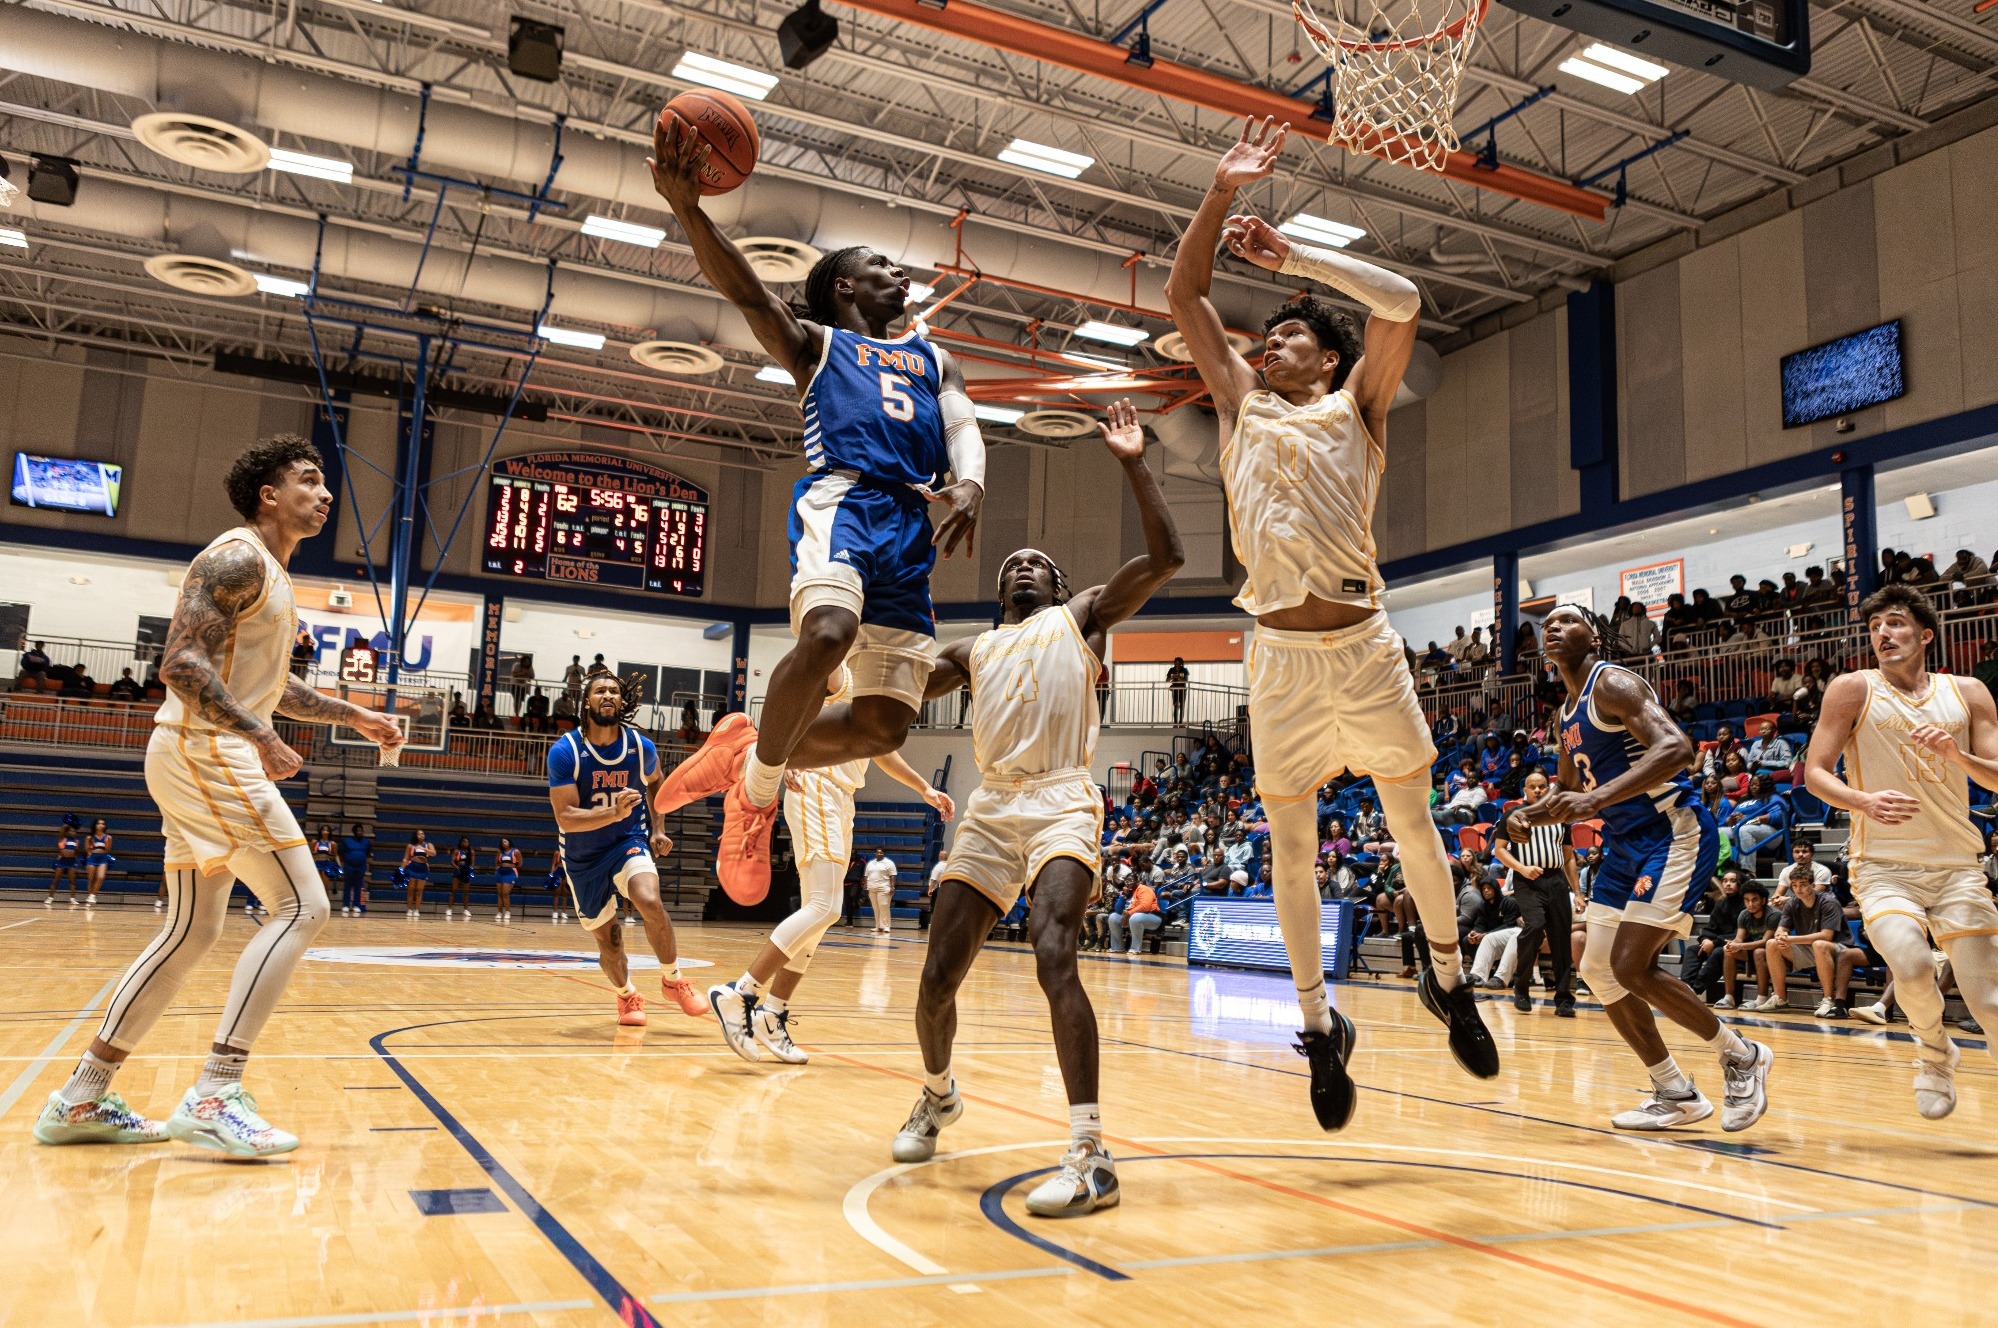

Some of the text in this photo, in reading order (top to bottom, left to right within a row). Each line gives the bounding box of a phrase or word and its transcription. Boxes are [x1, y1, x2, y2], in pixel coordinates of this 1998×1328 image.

[698, 106, 739, 152] NAIA
[856, 344, 924, 376] FMU
[879, 372, 914, 423] 5
[1277, 434, 1310, 482] 0
[526, 454, 682, 484] FLORIDA MEMORIAL UNIVERSITY
[505, 460, 697, 500] Welcome to the Lion's Den
[503, 486, 511, 499] 3
[556, 494, 578, 512] 62
[590, 489, 623, 508] 5:56
[614, 514, 624, 526] 2
[630, 504, 648, 522] 76
[557, 530, 566, 544] 6
[572, 532, 582, 546] 2
[616, 539, 624, 550] 4
[634, 541, 642, 554] 5
[514, 560, 524, 574] 2
[551, 564, 598, 582] LIONS
[552, 558, 574, 567] Home
[1844, 496, 1860, 630] SPIRITUA
[674, 580, 682, 592] 4
[1494, 578, 1502, 673] PHYSICA
[308, 624, 433, 673] FMU
[482, 603, 500, 700] MEMORIA
[343, 658, 373, 682] 25
[735, 657, 748, 701] WAY
[1006, 658, 1038, 704] 4
[1899, 743, 1946, 783] 13
[592, 770, 628, 789] FMU
